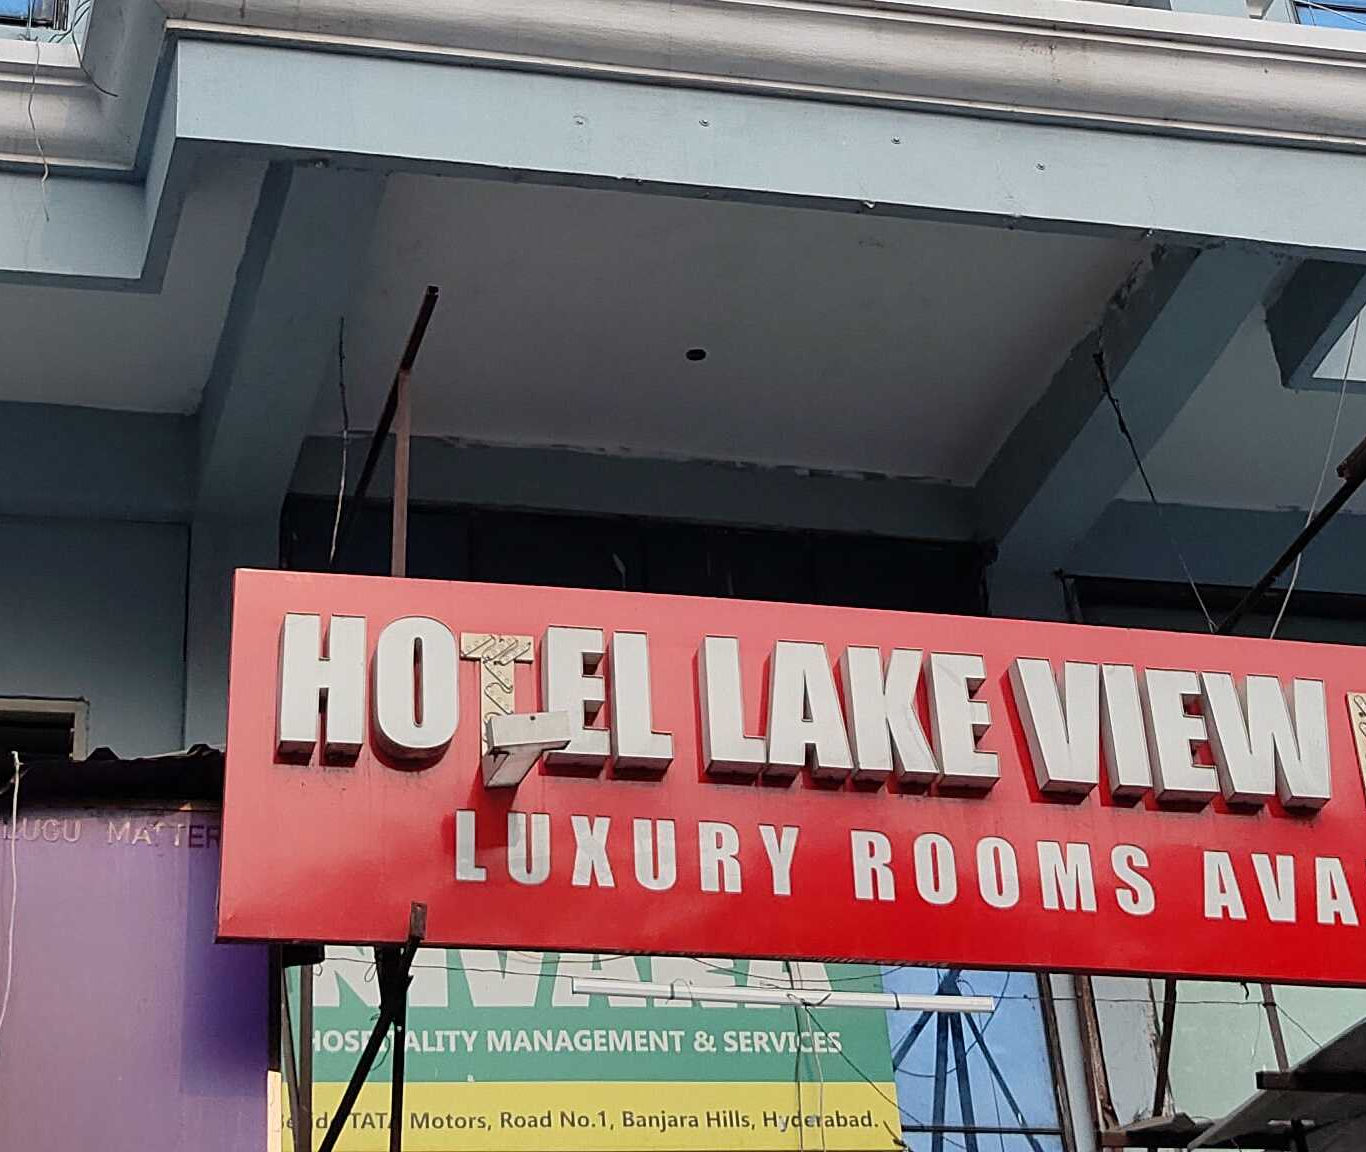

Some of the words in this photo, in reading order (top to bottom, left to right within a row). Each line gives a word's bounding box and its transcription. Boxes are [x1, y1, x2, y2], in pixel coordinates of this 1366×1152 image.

[278, 613, 673, 776] HOTEL
[700, 635, 1000, 790] LAKE
[1008, 657, 1330, 810] VIEW
[455, 810, 800, 896] LUXURY
[851, 830, 1155, 916] ROOMS
[312, 1029, 478, 1053] OSTALITY
[487, 1030, 685, 1053] MANAGEMENT
[693, 1030, 717, 1053] &
[723, 1030, 843, 1054] SERVICES
[349, 1112, 392, 1130] TAT
[410, 1111, 492, 1132] Motors,
[500, 1110, 552, 1130] Road
[560, 1110, 615, 1131] No.1,
[622, 1110, 699, 1132] Banjara
[706, 1110, 756, 1132] Hills,
[763, 1110, 879, 1133] Hyderabad.
